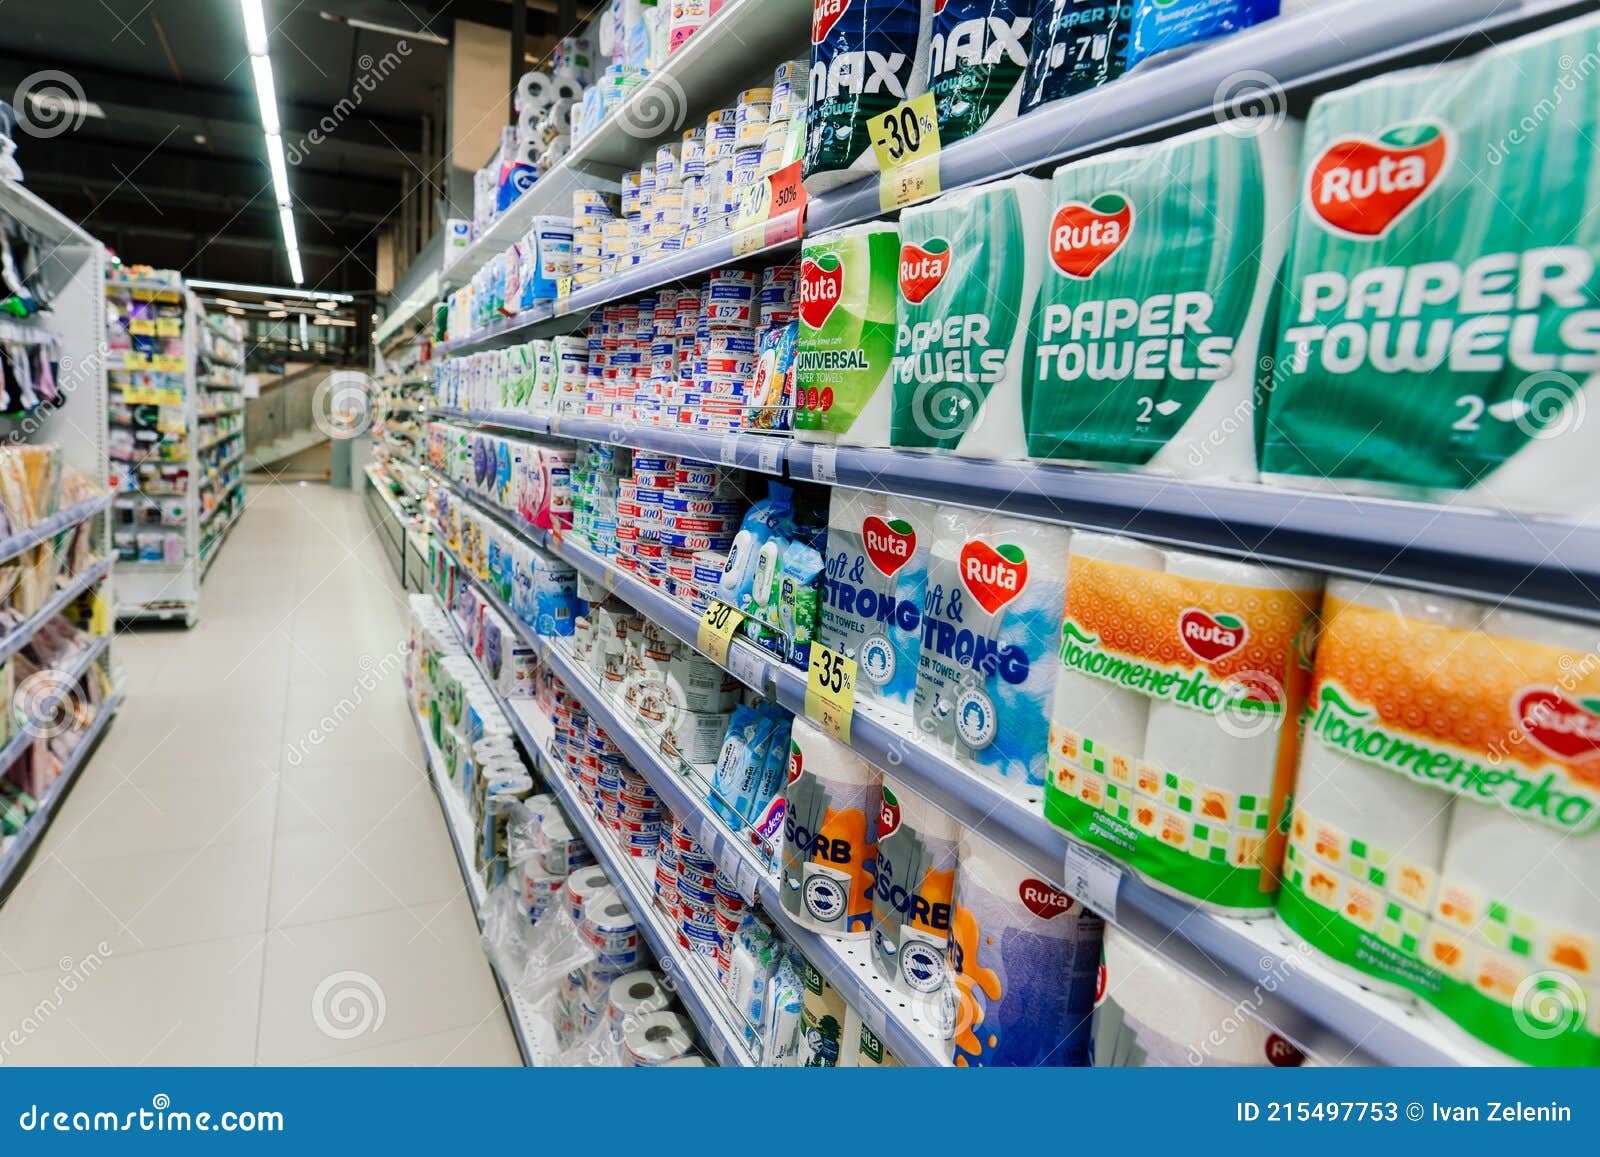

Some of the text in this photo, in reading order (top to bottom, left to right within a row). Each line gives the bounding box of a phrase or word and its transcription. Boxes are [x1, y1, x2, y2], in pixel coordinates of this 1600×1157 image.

[1319, 153, 1426, 205] Ruta
[775, 183, 797, 207] -50%
[1054, 216, 1120, 252] Ruta
[900, 258, 942, 283] Ruta
[800, 277, 837, 304] Ruta
[1296, 246, 1595, 323] PAPER
[720, 306, 738, 318] 157
[1041, 290, 1214, 342] PAPER
[896, 313, 990, 353] PAPER
[1284, 309, 1600, 376] TOWELS
[740, 362, 753, 373] 15
[799, 350, 868, 370] UNIVERSAL
[892, 349, 1007, 385] TOWELS
[1036, 335, 1234, 382] TOWELS
[713, 382, 732, 391] 157
[1136, 396, 1153, 424] 2
[1450, 395, 1486, 432] 2
[689, 472, 710, 485] 300
[690, 501, 712, 514] 300
[663, 517, 675, 527] 00
[688, 537, 710, 549] 300
[866, 531, 907, 557] Ruta
[826, 552, 865, 584] oft &
[966, 557, 1017, 591] Ruta
[924, 583, 964, 623] oft &
[836, 614, 865, 634] TOWELS
[1184, 621, 1236, 648] Ruta
[922, 616, 1030, 685] TRONG
[813, 650, 851, 693] -35%
[932, 659, 961, 684] TOWELS
[880, 801, 893, 827] ta
[684, 868, 702, 884] 202
[874, 875, 951, 930] SORB
[1025, 886, 1068, 909] Ruta
[696, 912, 715, 925] 202
